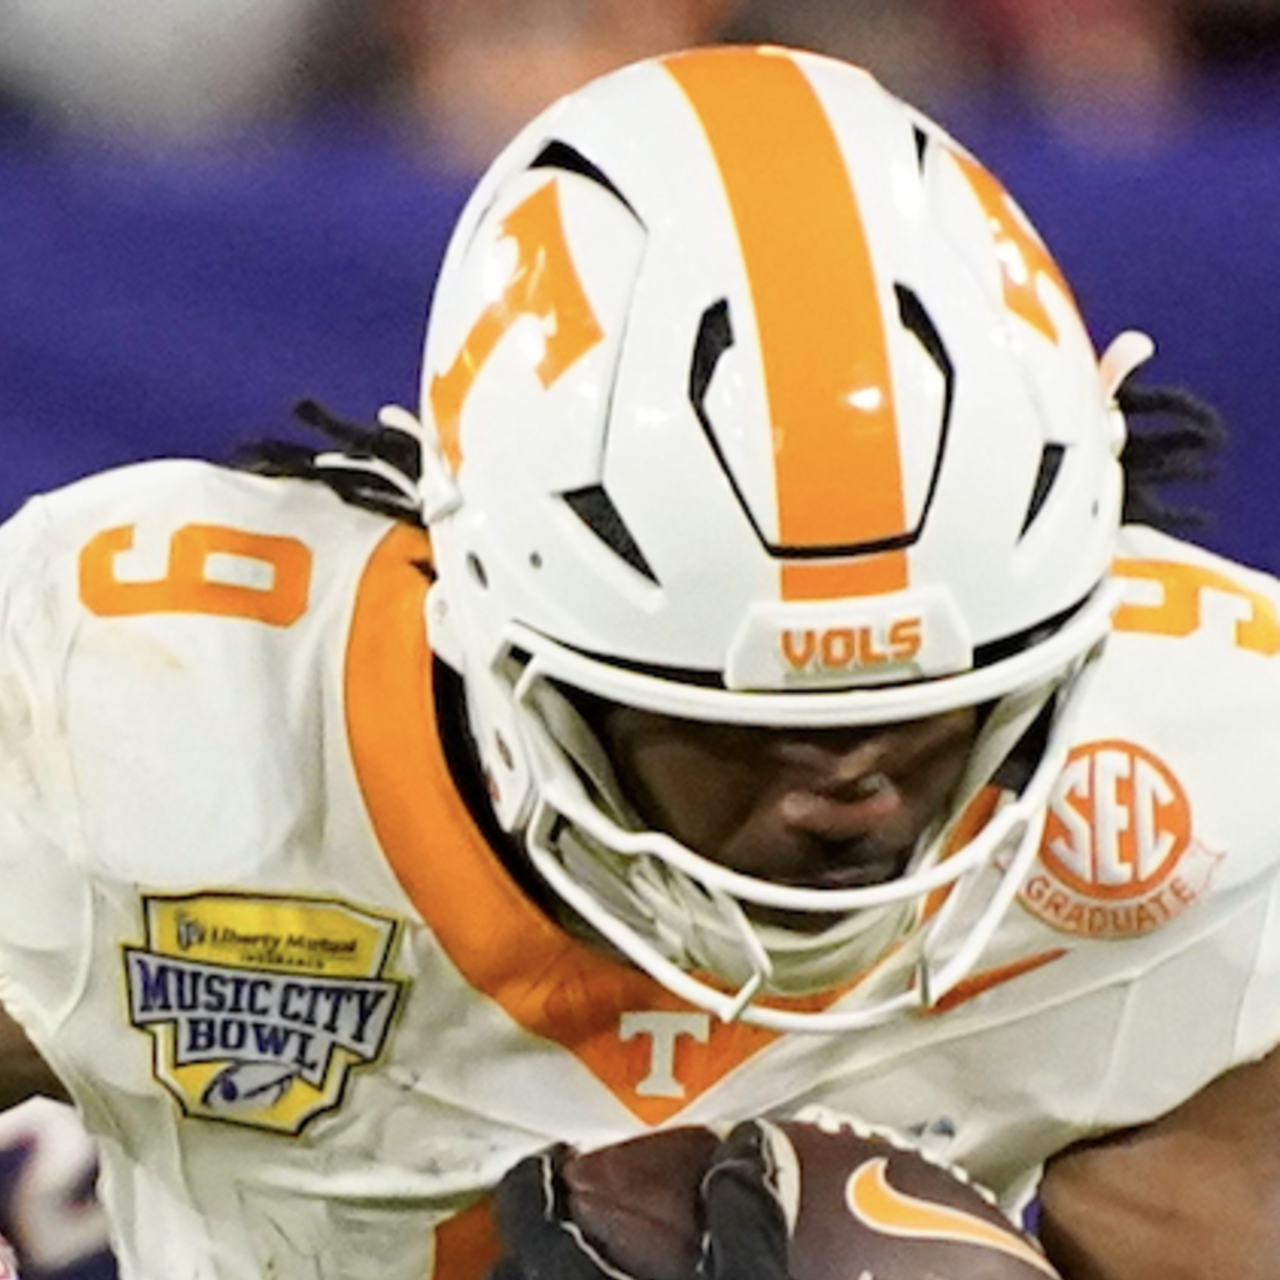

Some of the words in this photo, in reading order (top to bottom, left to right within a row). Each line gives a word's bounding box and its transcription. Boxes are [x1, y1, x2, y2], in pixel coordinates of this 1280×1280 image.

[77, 521, 314, 630] 9
[780, 616, 922, 670] VOLS
[1046, 750, 1177, 884] SEC
[1025, 873, 1197, 933] GRADUATE
[135, 957, 272, 1017] MUSIC
[278, 981, 388, 1045] CITY
[185, 1017, 318, 1072] BOWL
[619, 1009, 710, 1099] T
